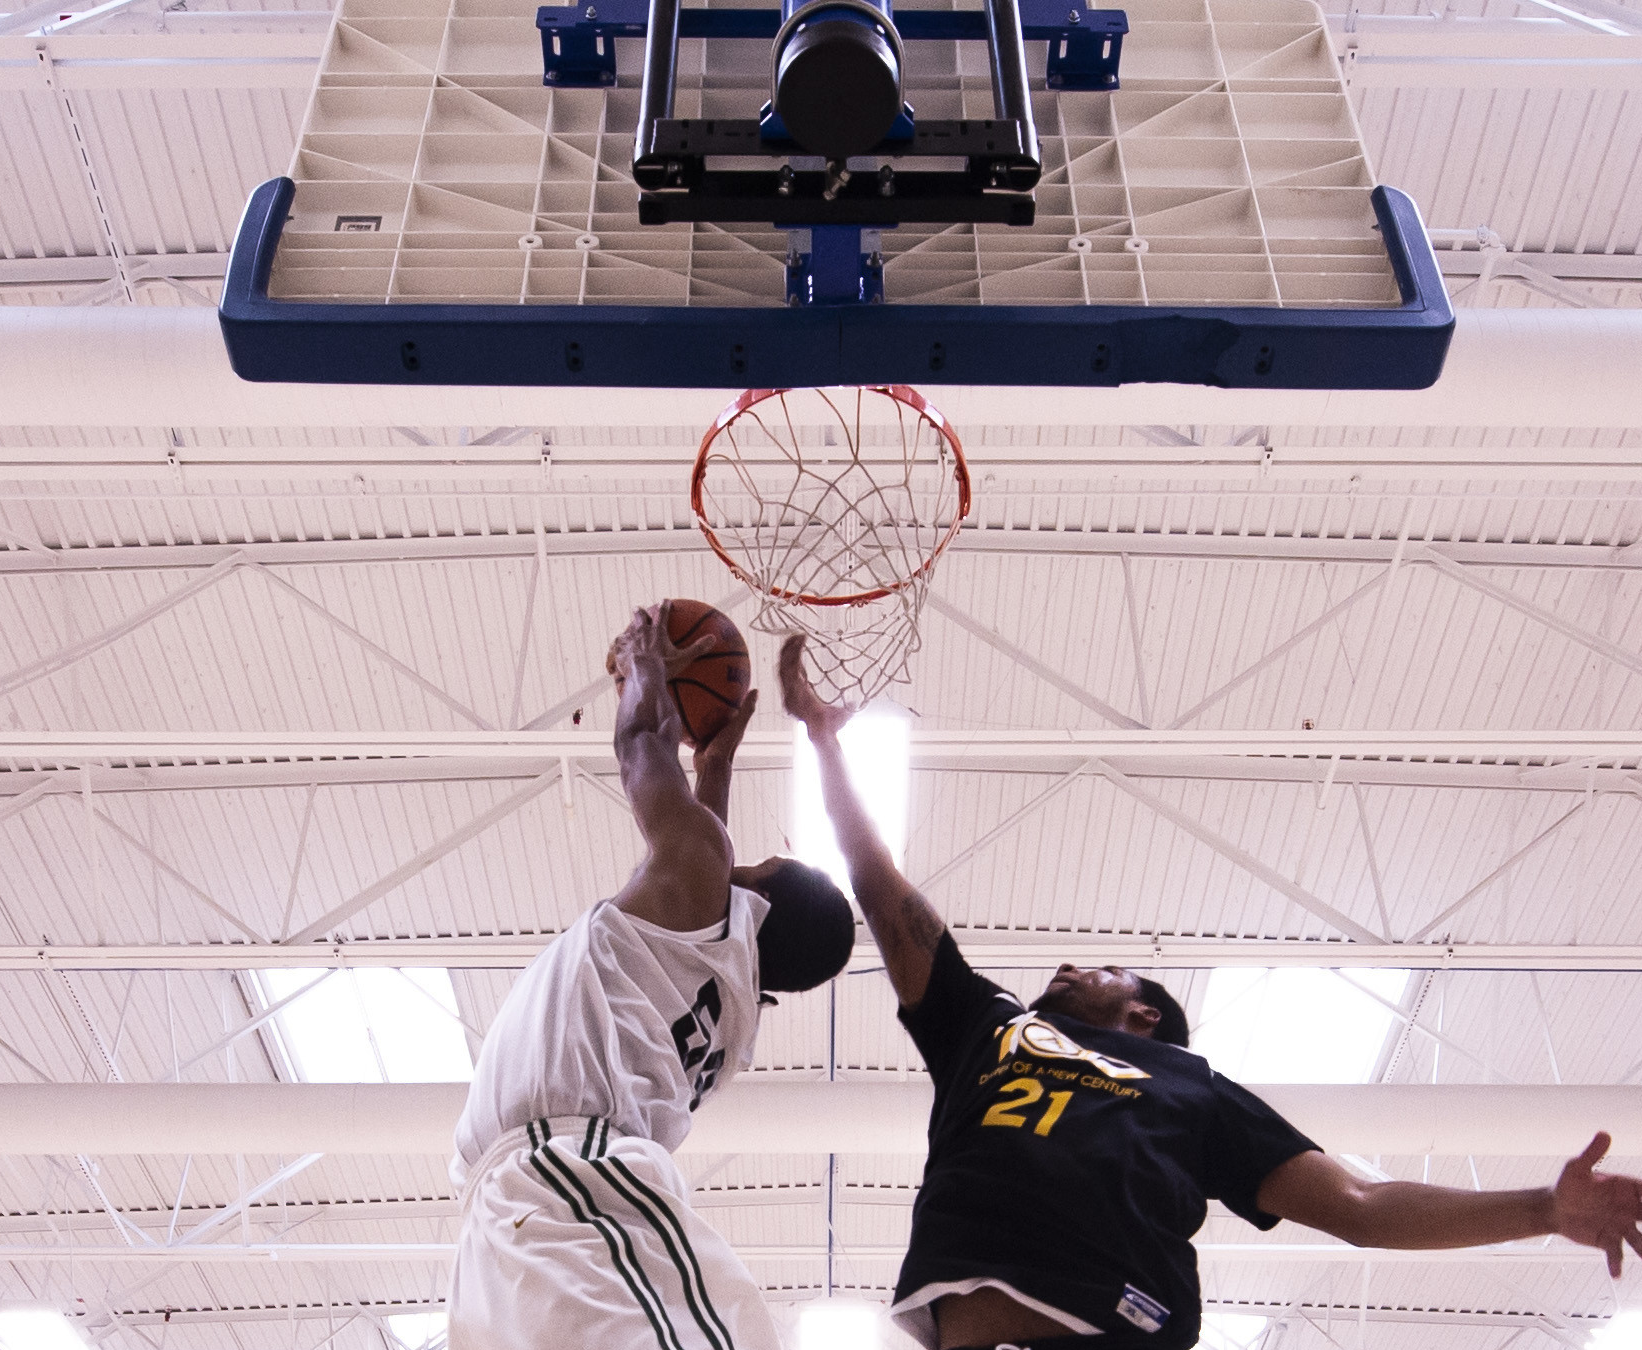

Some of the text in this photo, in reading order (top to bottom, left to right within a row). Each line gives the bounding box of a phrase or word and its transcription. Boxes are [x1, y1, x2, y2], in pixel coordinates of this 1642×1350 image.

[1012, 1061, 1033, 1074] OF
[1035, 1066, 1045, 1076] A
[1080, 1075, 1143, 1100] CENTURY
[981, 1077, 1074, 1138] 21
